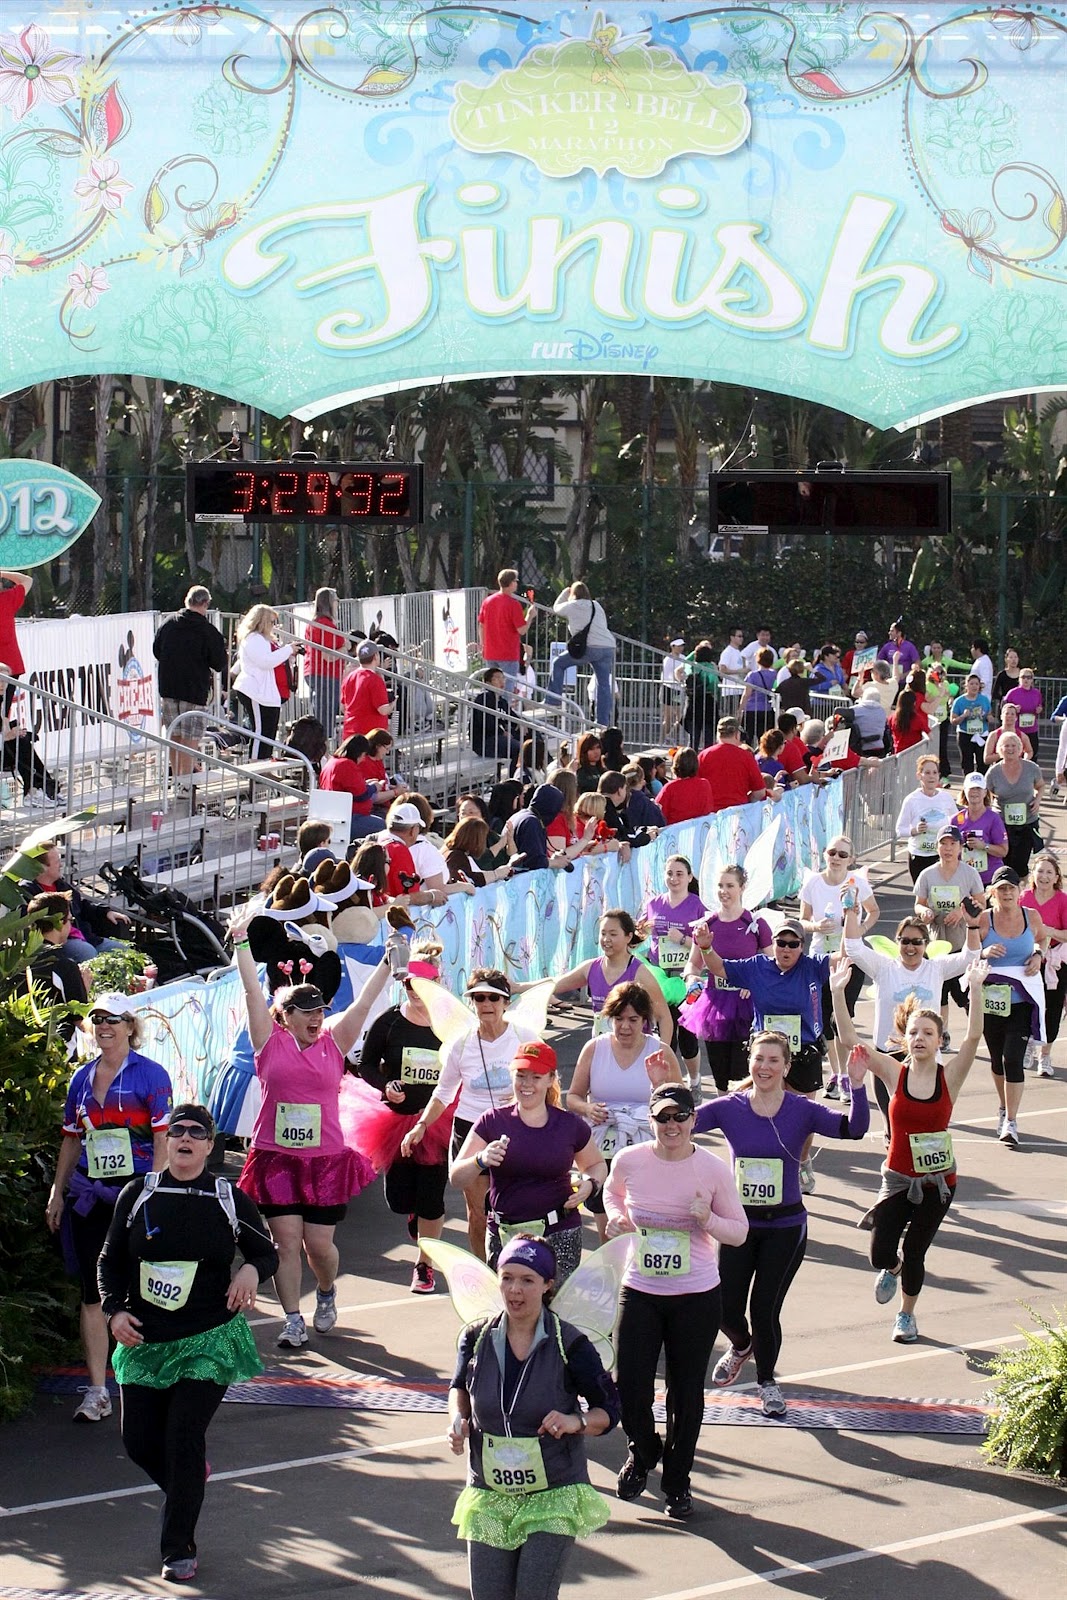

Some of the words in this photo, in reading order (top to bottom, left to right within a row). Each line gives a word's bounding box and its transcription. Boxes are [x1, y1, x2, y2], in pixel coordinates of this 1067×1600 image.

[465, 91, 618, 129] TINKER
[634, 98, 727, 134] BELL
[527, 136, 674, 151] MARATHON
[223, 183, 960, 356] Finish
[1008, 813, 1025, 822] 9423
[661, 952, 690, 963] 10724
[985, 999, 1006, 1011] 8333
[404, 1066, 441, 1081] 21063
[282, 1126, 314, 1141] 4054
[94, 1154, 126, 1170] 1732
[740, 1160, 745, 1169] C
[916, 1149, 951, 1167] 10651
[742, 1183, 776, 1198] 5790
[643, 1253, 682, 1269] 6879
[147, 1277, 182, 1302] 9992
[488, 1438, 494, 1448] B
[492, 1468, 537, 1486] 3895
